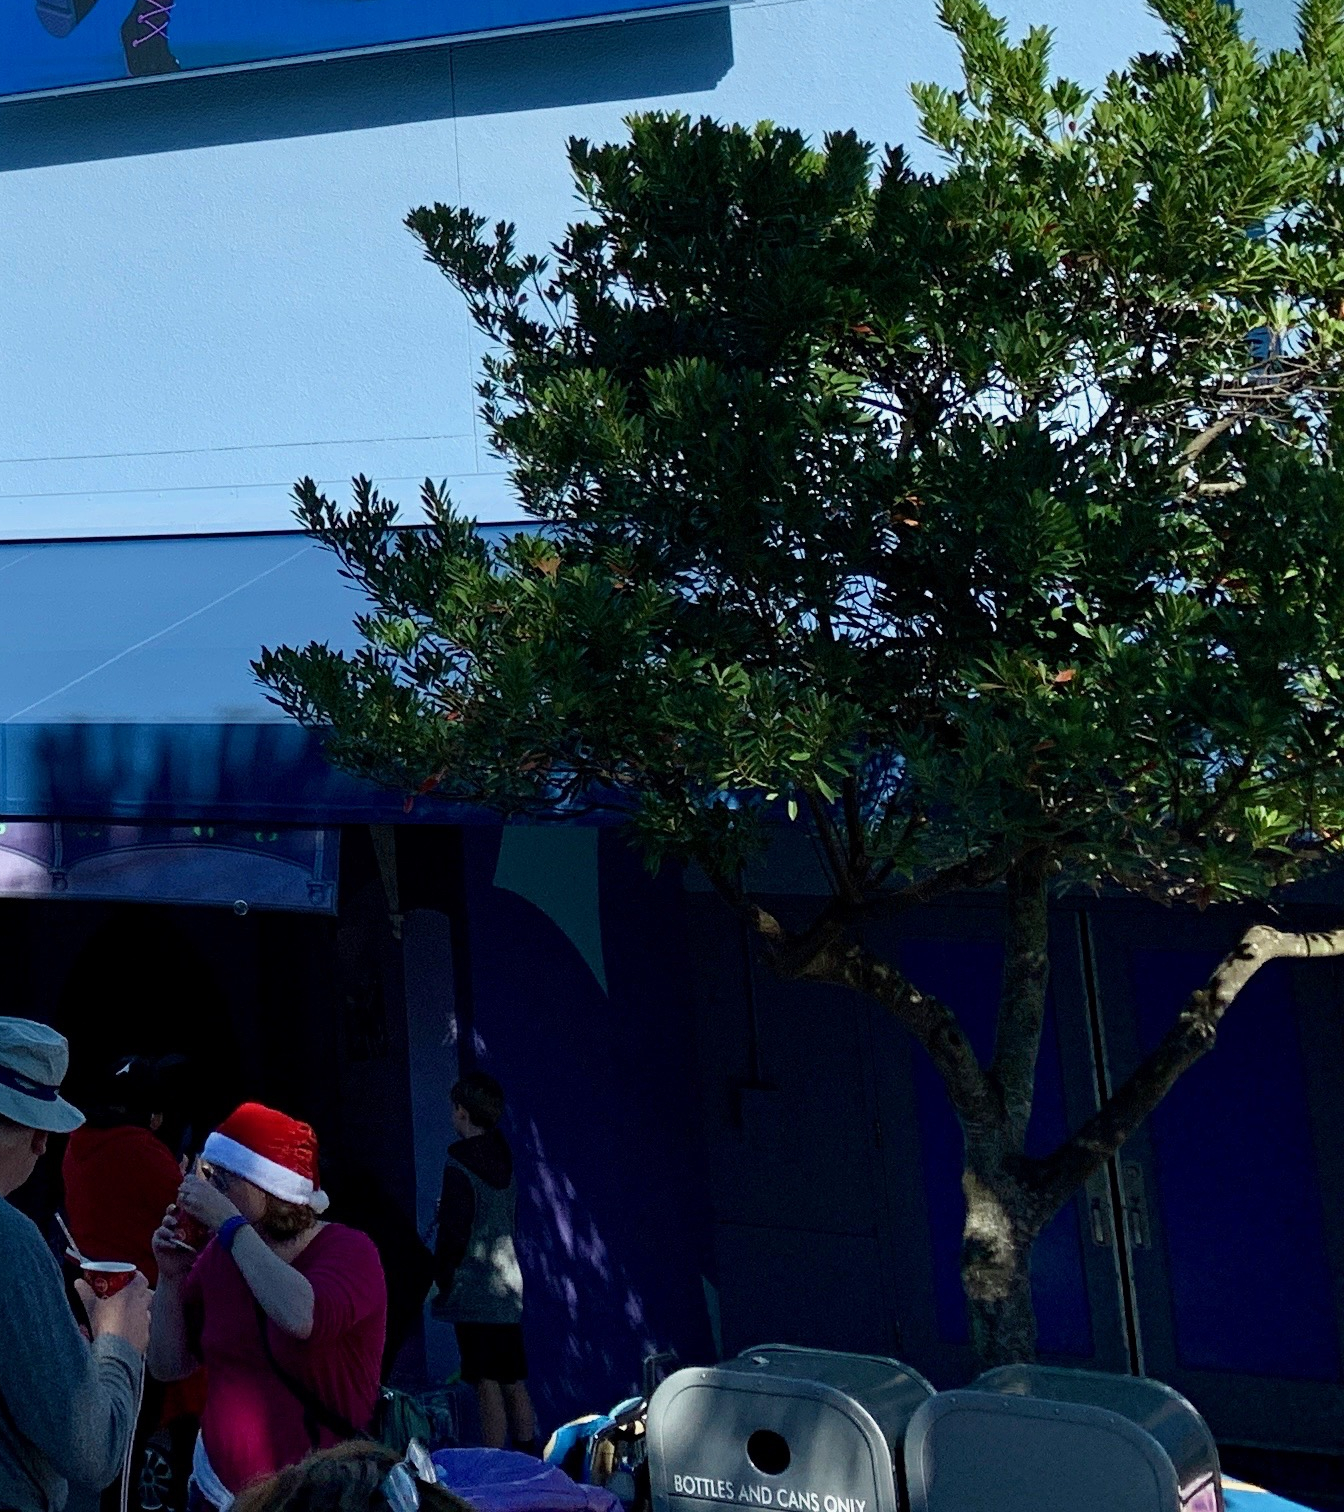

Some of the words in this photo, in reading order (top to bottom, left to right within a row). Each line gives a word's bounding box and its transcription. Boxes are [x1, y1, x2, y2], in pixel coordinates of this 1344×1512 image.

[673, 1474, 734, 1500] BOTTLES
[738, 1485, 772, 1505] AND
[776, 1488, 820, 1512] CANS
